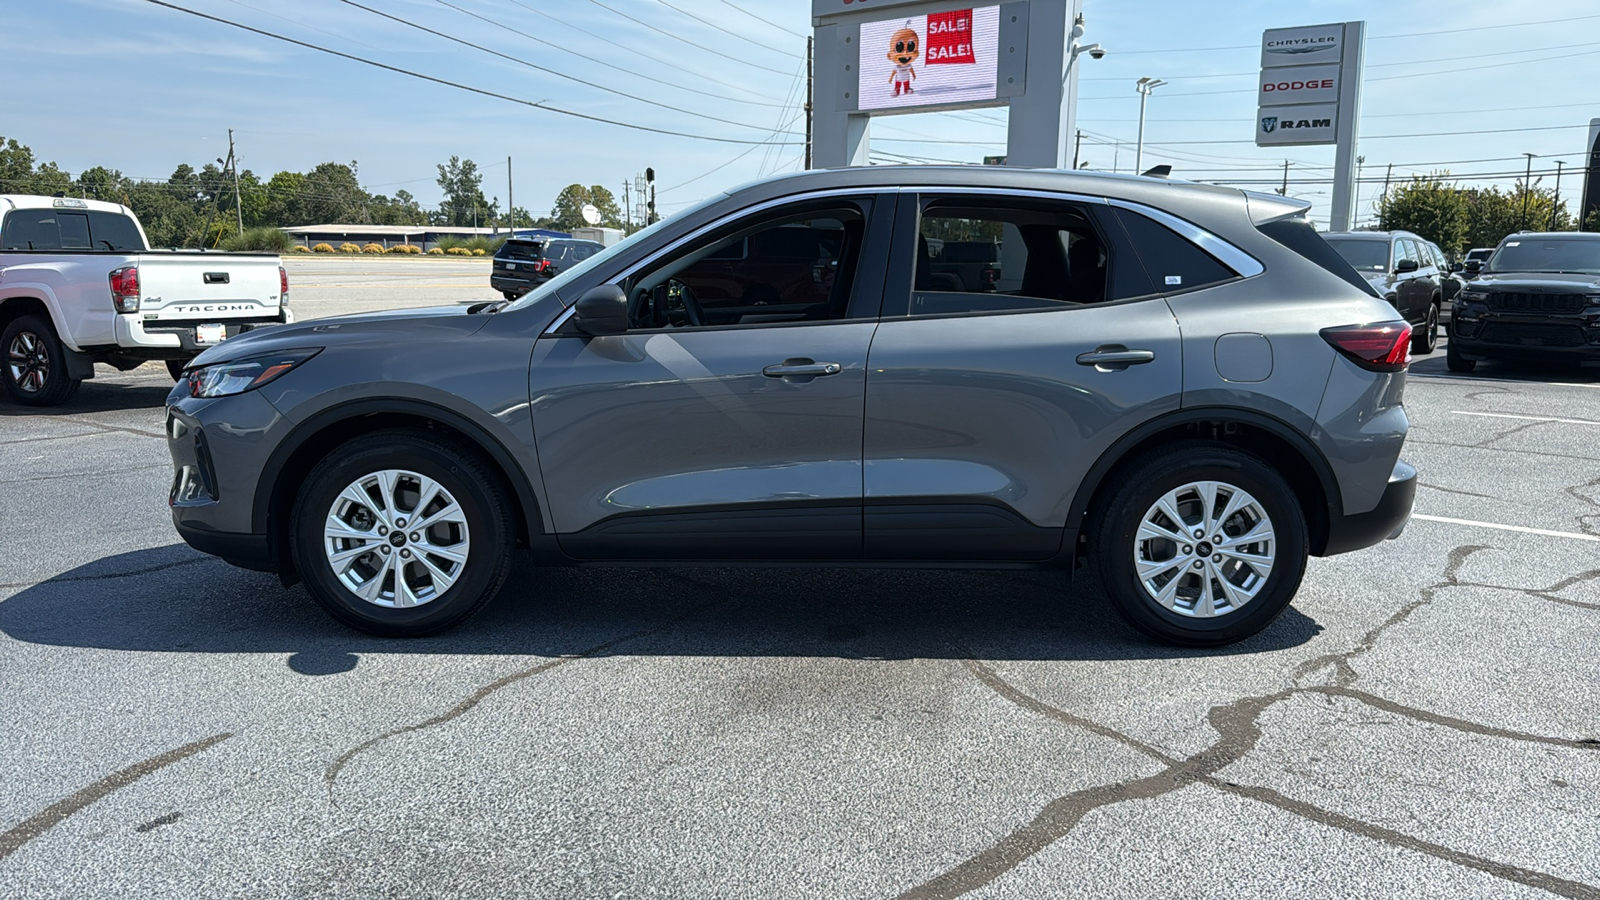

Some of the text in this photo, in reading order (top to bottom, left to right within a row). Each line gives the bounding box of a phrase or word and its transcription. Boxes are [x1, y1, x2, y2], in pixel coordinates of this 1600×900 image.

[929, 18, 969, 34] SALE!
[1267, 36, 1335, 47] CHRYSLER
[928, 43, 971, 60] SALE!
[1263, 79, 1334, 92] DODGE
[1280, 118, 1331, 129] RAM
[174, 304, 255, 313] TACOMA
